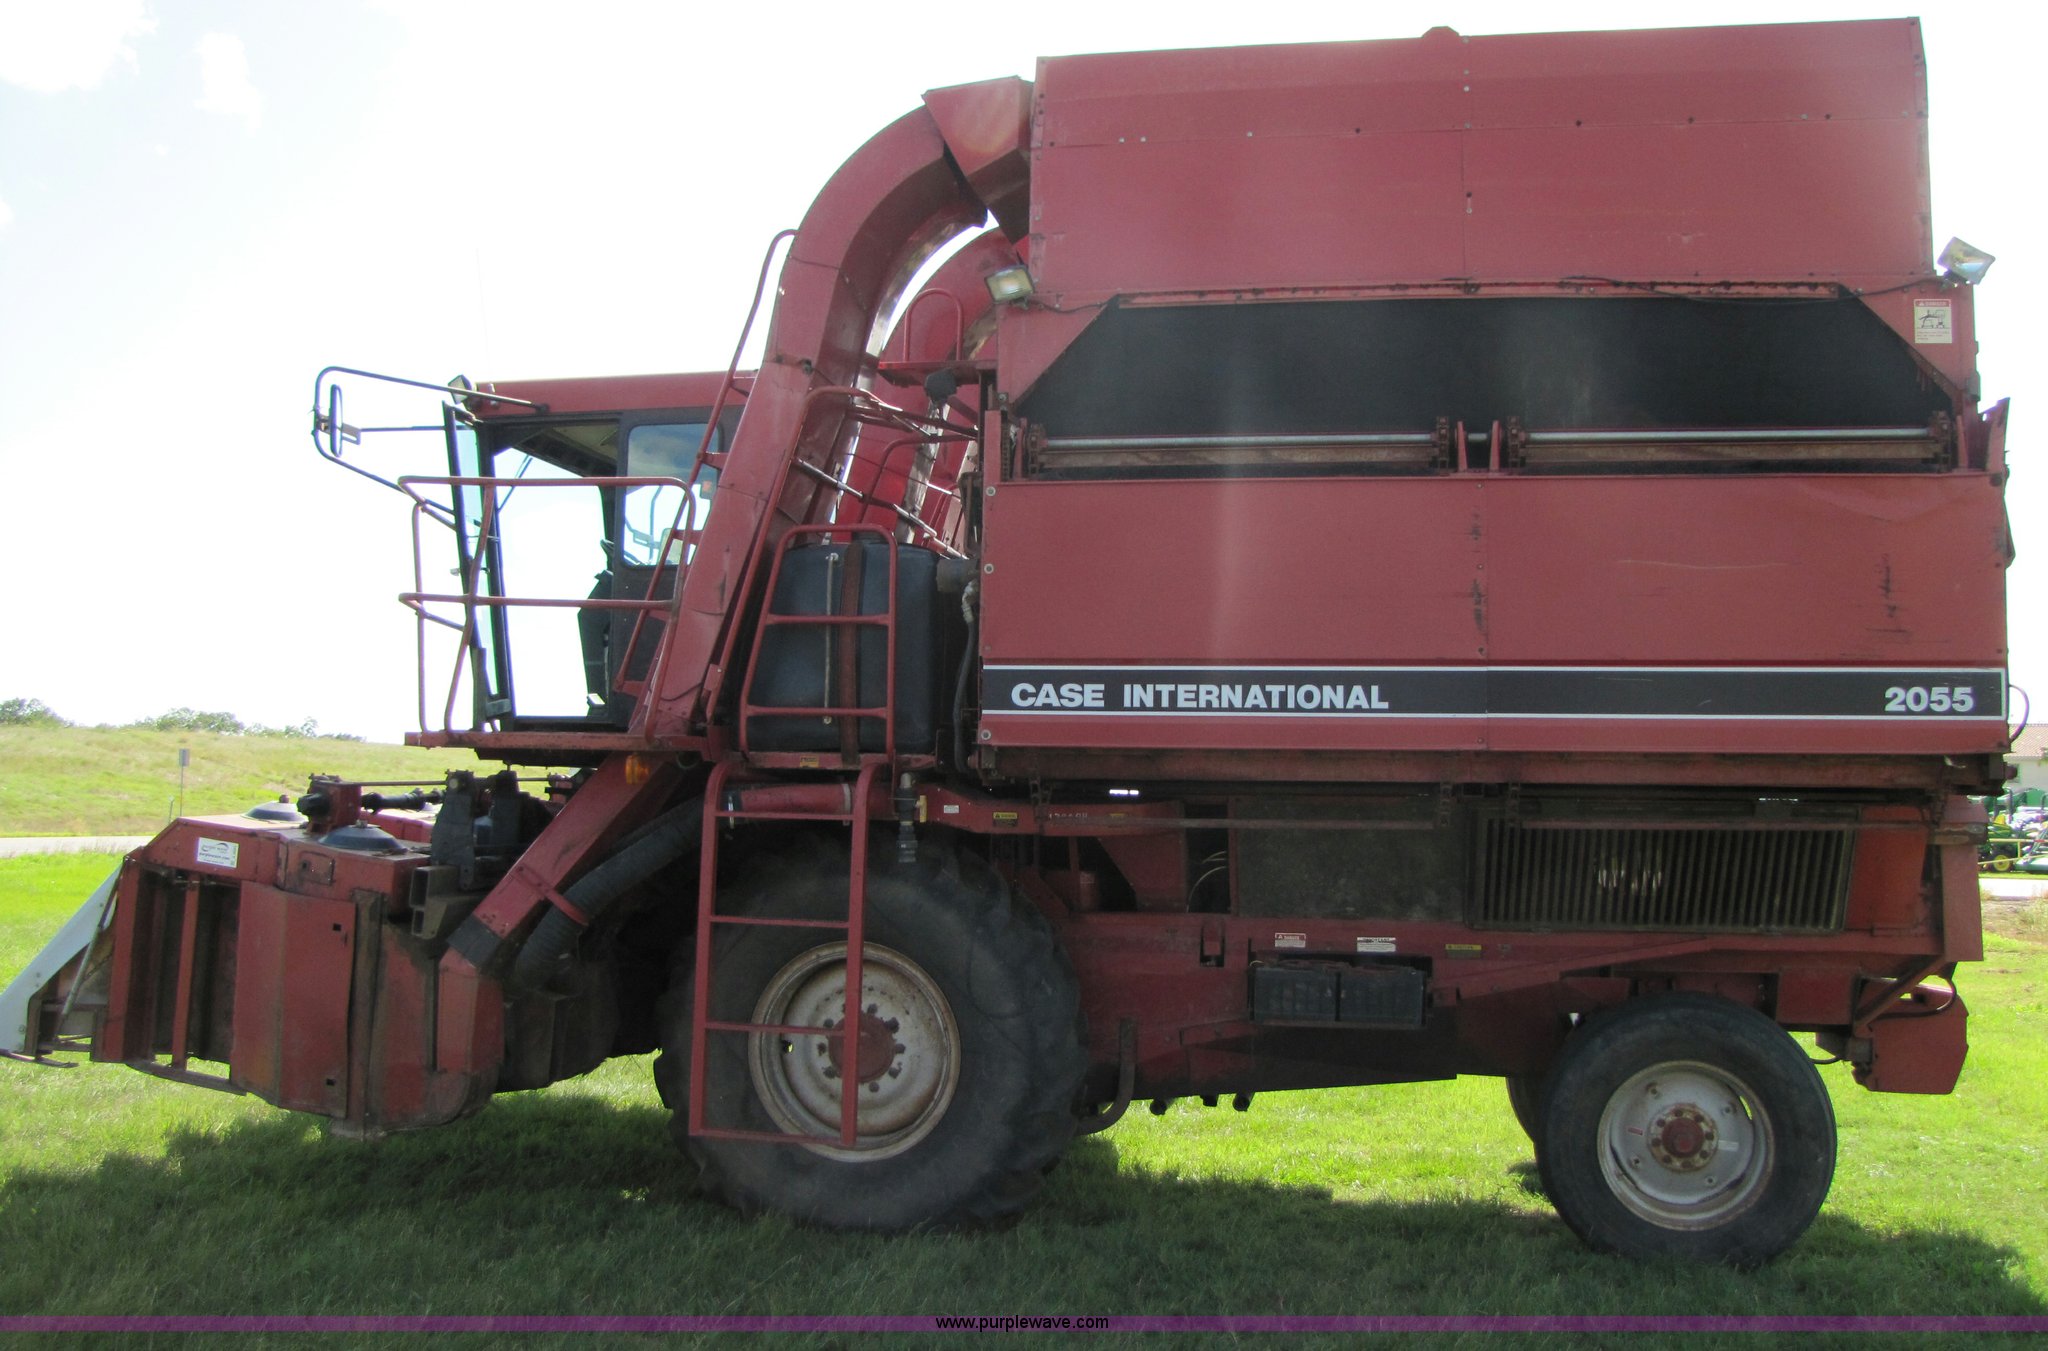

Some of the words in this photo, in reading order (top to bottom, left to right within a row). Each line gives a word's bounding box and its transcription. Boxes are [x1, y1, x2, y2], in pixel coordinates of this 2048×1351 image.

[1011, 683, 1105, 708] CASE
[1123, 684, 1389, 710] INTERNATIONAL
[1884, 686, 1975, 712] 2055
